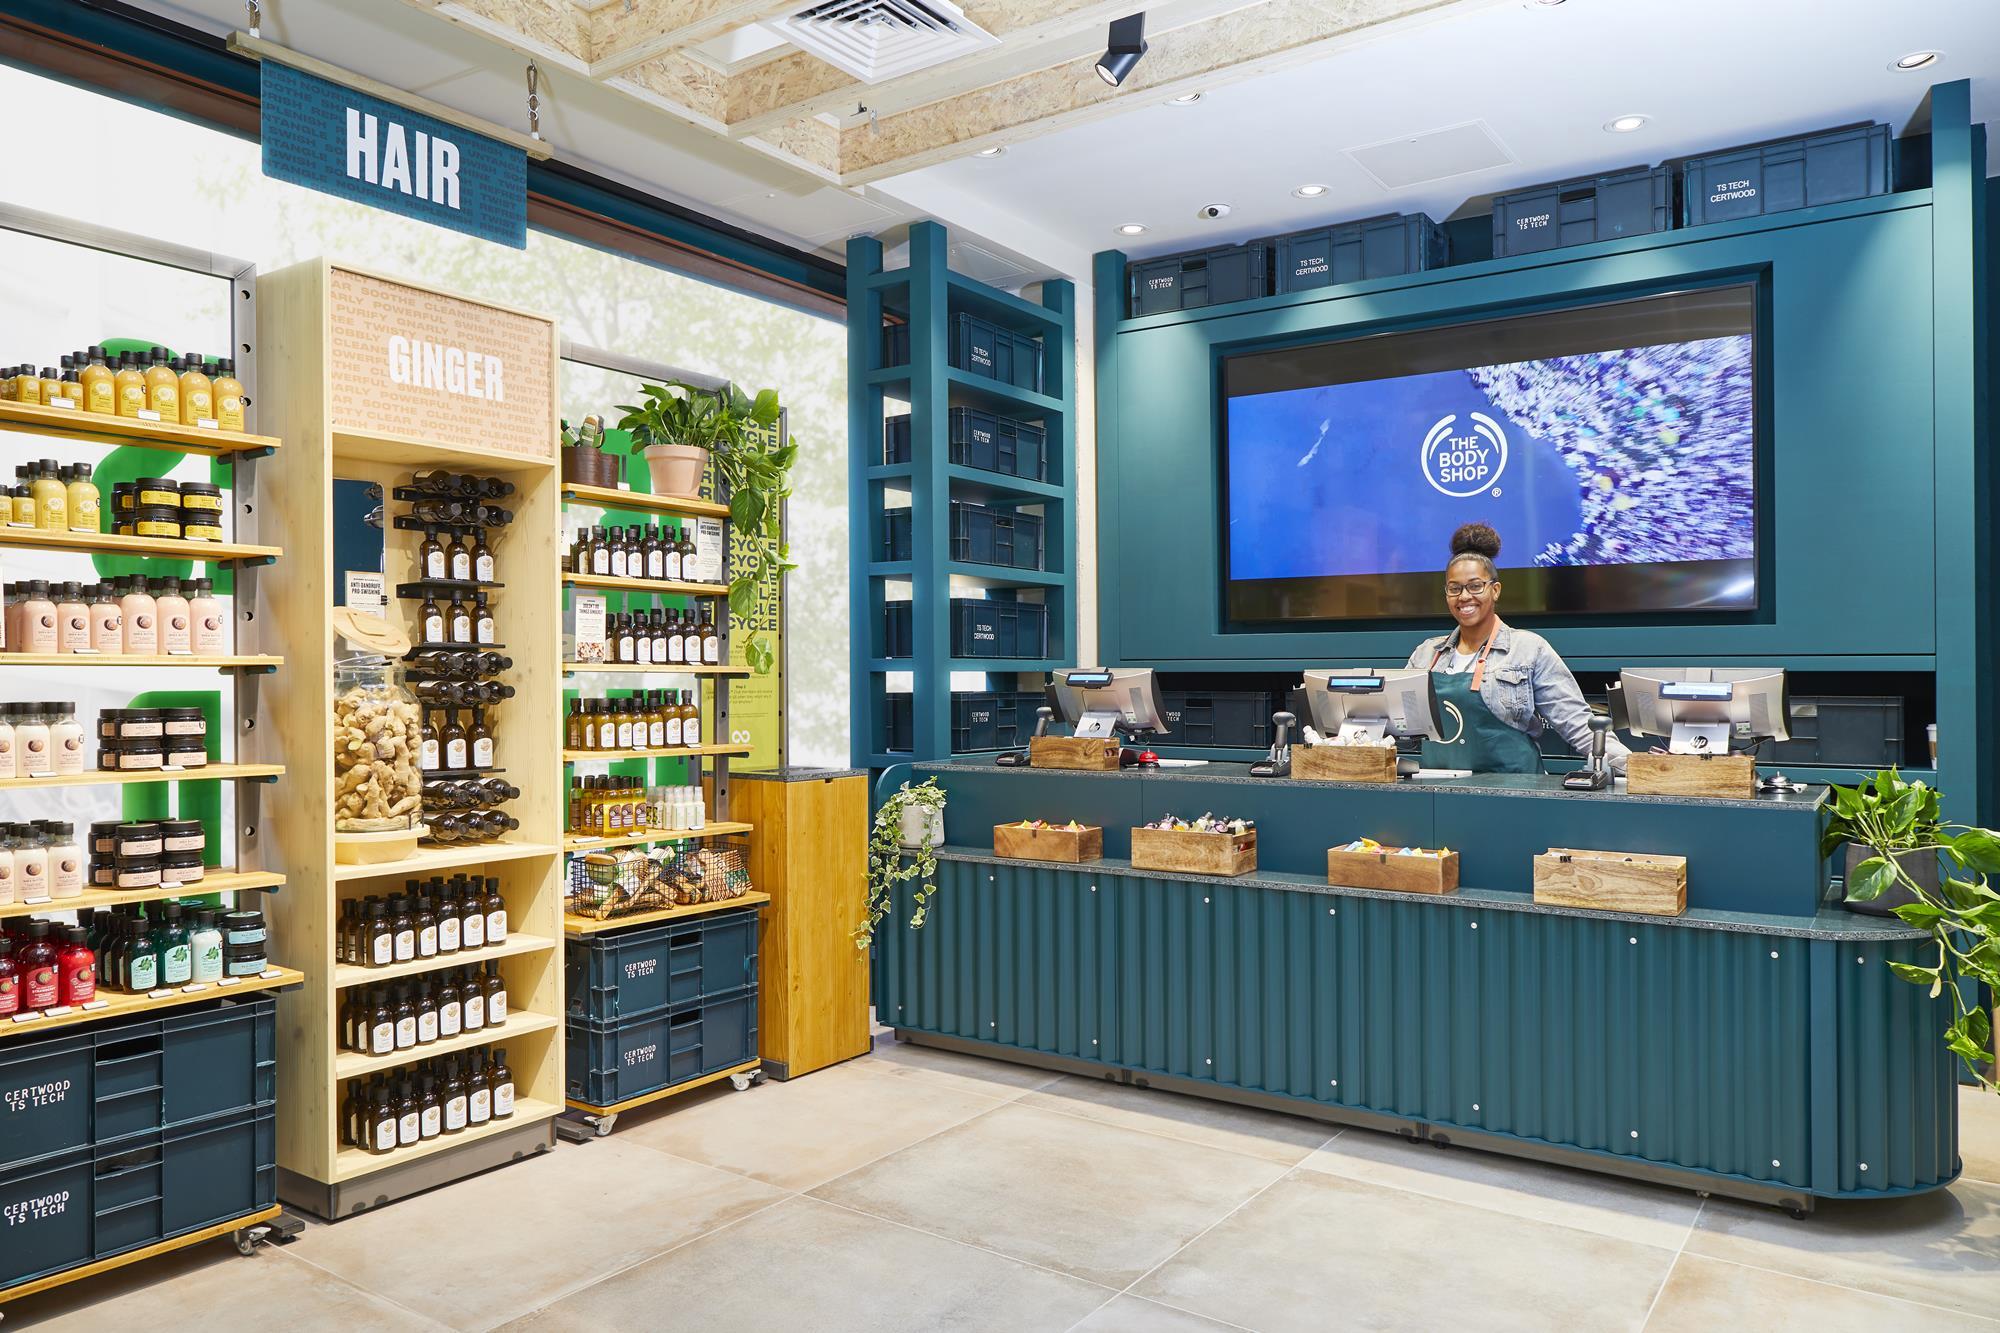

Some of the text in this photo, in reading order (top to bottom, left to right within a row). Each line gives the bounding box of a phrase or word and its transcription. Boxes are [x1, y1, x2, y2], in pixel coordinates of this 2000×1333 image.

[347, 107, 460, 210] HAIR
[1717, 180, 1750, 192] TS TECH
[1710, 189, 1756, 202] CERTWOOD
[1516, 214, 1550, 225] CERTWOOD
[1530, 220, 1547, 228] TECH
[1308, 257, 1324, 266] TECH
[1296, 265, 1328, 276] CERTWOOD
[1149, 277, 1174, 285] CERTWOOD
[360, 286, 415, 306] SOOTHE
[424, 301, 480, 321] CLEANSE
[336, 303, 386, 321] PURIFY
[396, 317, 448, 335] GNARLY
[457, 330, 522, 351] POWERFUL
[373, 300, 445, 324] POWERFUL
[502, 331, 528, 343] FREE
[363, 320, 416, 339] TWISTY
[425, 334, 465, 349] CLEAR
[334, 337, 388, 355] CLEANS
[979, 348, 988, 357] TECH
[972, 354, 992, 366] CERTWOOD
[388, 335, 504, 402] GINGER
[380, 391, 452, 409] POWERFUL
[398, 382, 439, 396] SWISH
[448, 392, 479, 404] FREE
[362, 399, 416, 414] SOOTHE
[366, 411, 411, 424] CLEAR
[420, 419, 471, 434] SOOTHE
[377, 424, 425, 437] PURIFY
[1449, 436, 1478, 450] THE
[1439, 448, 1489, 467] BODY
[1440, 466, 1488, 482] SHOP
[624, 959, 657, 972] CERTWOOD
[627, 967, 654, 979] TS TECH
[624, 1044, 656, 1060] CERTWOOD
[627, 1052, 654, 1066] TS TECH
[5, 1080, 71, 1102] CERTWOOD
[10, 1091, 65, 1112] TS TECH
[4, 1191, 69, 1216] CERTWOOD
[8, 1202, 65, 1226] TS TECH
